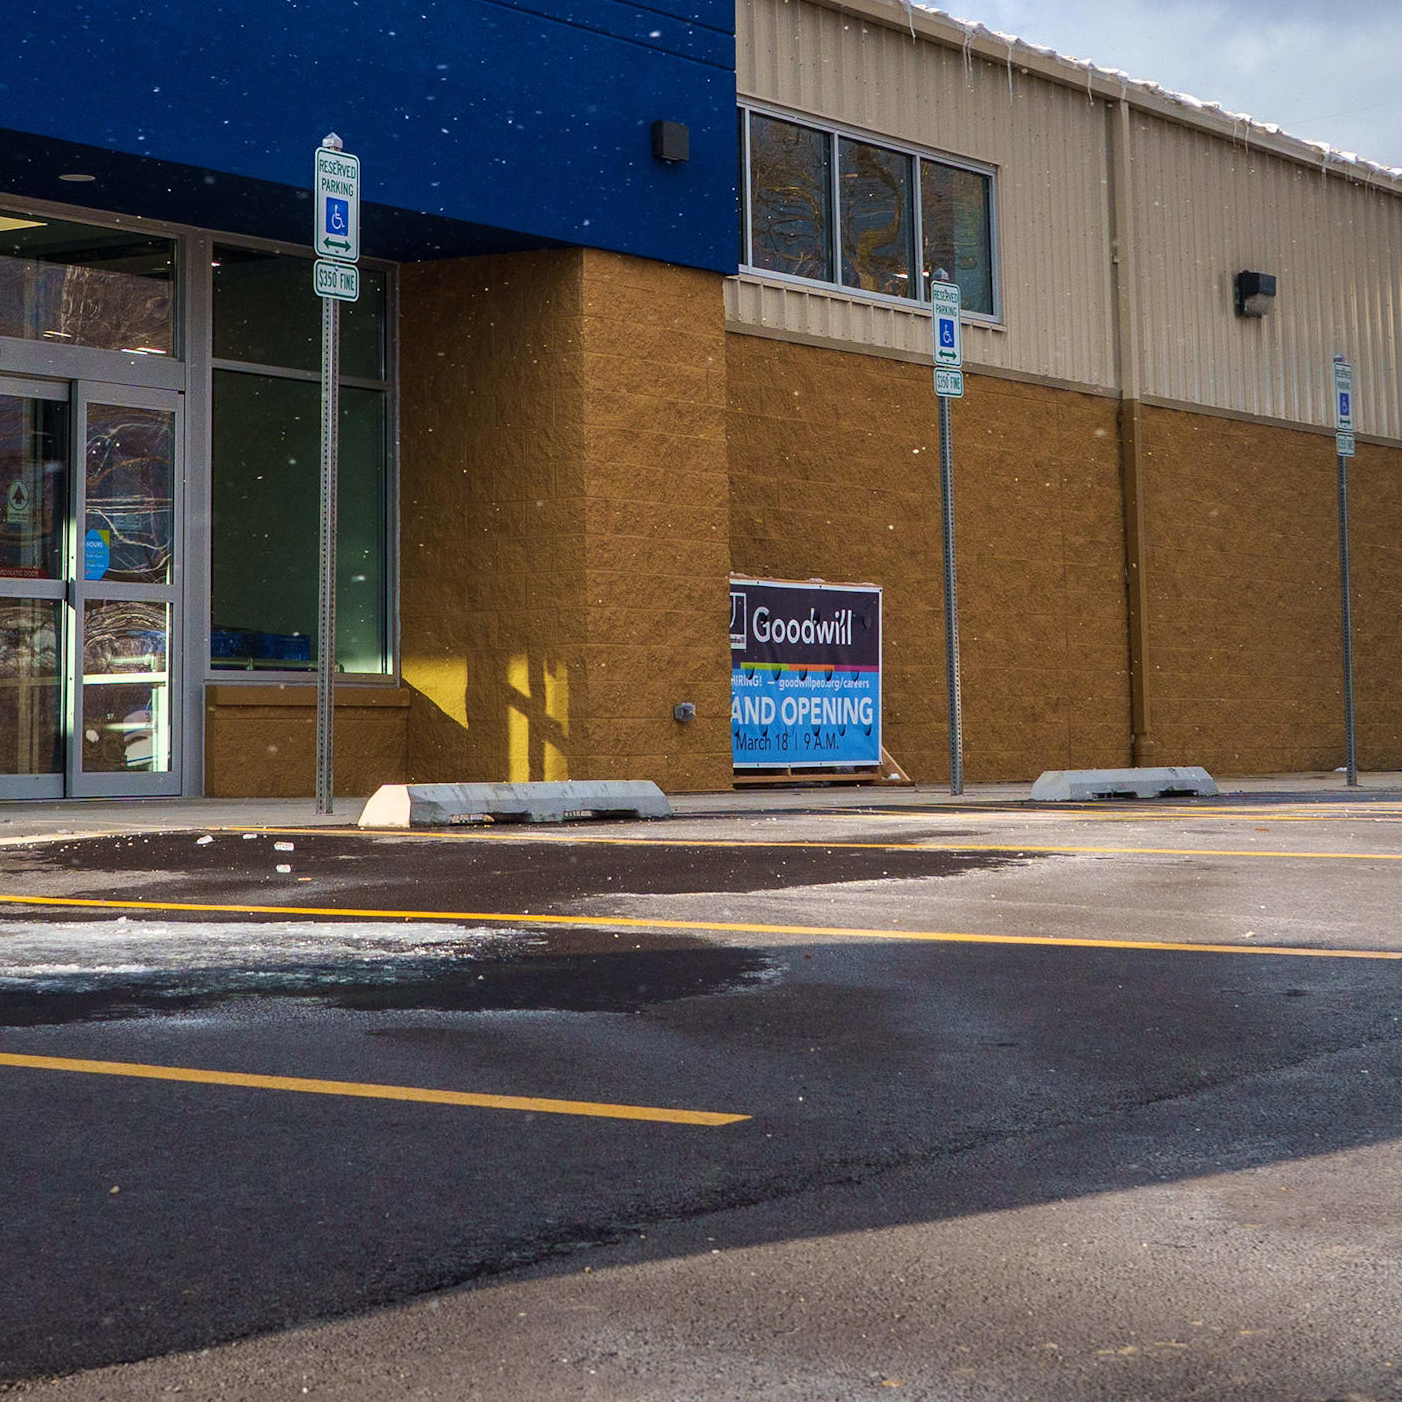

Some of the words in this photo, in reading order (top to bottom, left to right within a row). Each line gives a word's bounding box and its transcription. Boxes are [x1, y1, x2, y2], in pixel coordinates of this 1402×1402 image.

[319, 159, 356, 180] RESERVED
[321, 178, 354, 197] PARKING
[319, 269, 337, 288] $350
[340, 273, 355, 291] FINE
[936, 303, 957, 317] PARKING
[752, 606, 853, 645] Goodwill
[731, 696, 776, 725] AND
[781, 696, 873, 725] OPENING
[736, 733, 771, 750] March
[775, 734, 789, 750] 18
[804, 734, 811, 750] 9
[814, 733, 839, 750] A.M.
